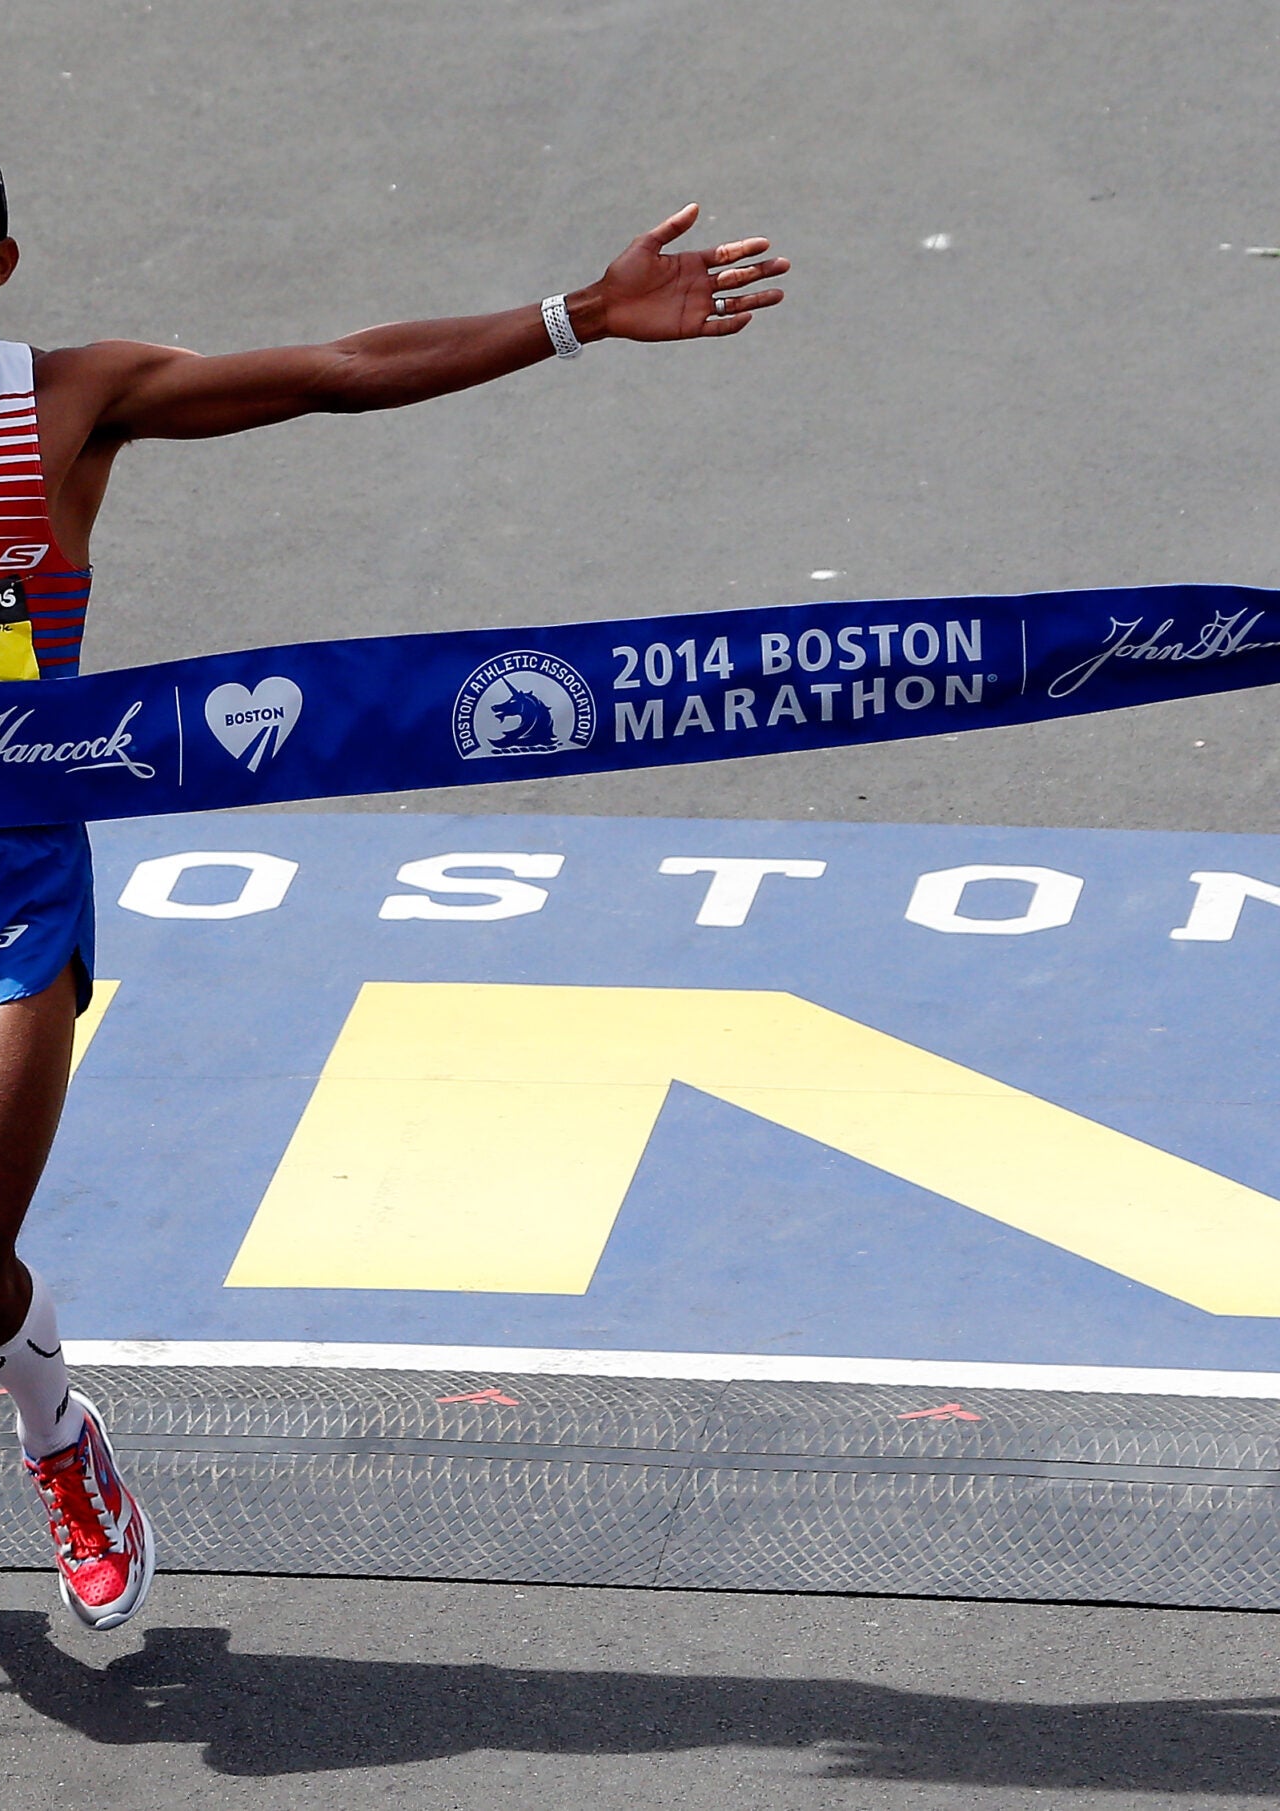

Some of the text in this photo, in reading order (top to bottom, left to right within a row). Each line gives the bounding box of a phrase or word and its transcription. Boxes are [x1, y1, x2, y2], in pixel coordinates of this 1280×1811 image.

[612, 619, 982, 690] 2014 BOSTON
[1048, 616, 1184, 698] John
[225, 706, 285, 727] BOSTON
[458, 655, 591, 750] BOSTON ATHLETIC ASSOCIATION
[614, 674, 983, 743] MARATHON
